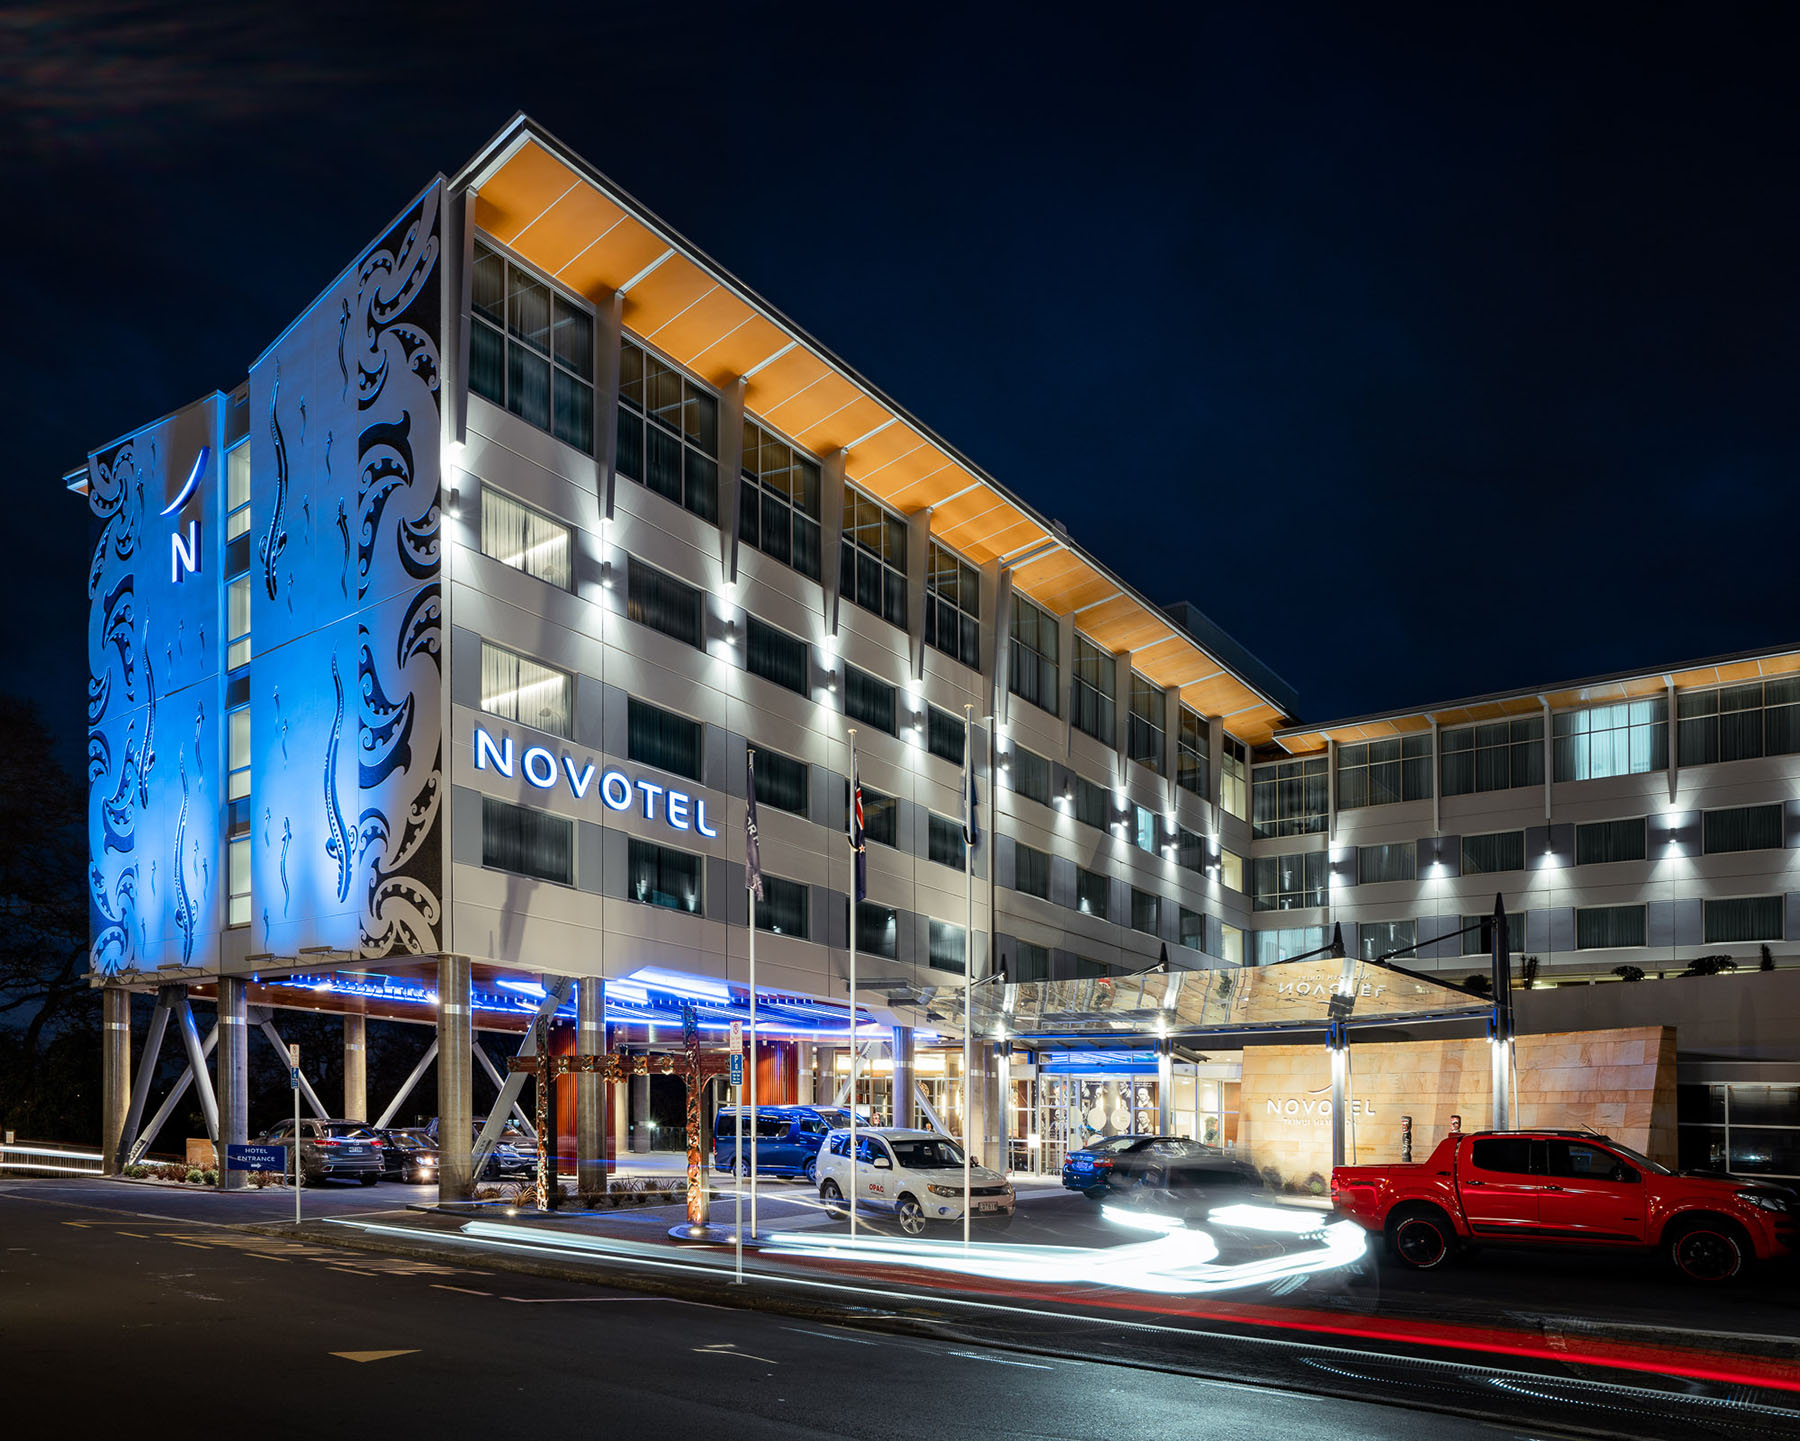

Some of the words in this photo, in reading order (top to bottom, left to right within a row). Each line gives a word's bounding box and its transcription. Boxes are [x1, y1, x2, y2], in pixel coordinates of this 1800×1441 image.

[172, 520, 200, 583] N
[475, 728, 717, 837] NOVOTEL
[1267, 1099, 1376, 1115] NOVOEL
